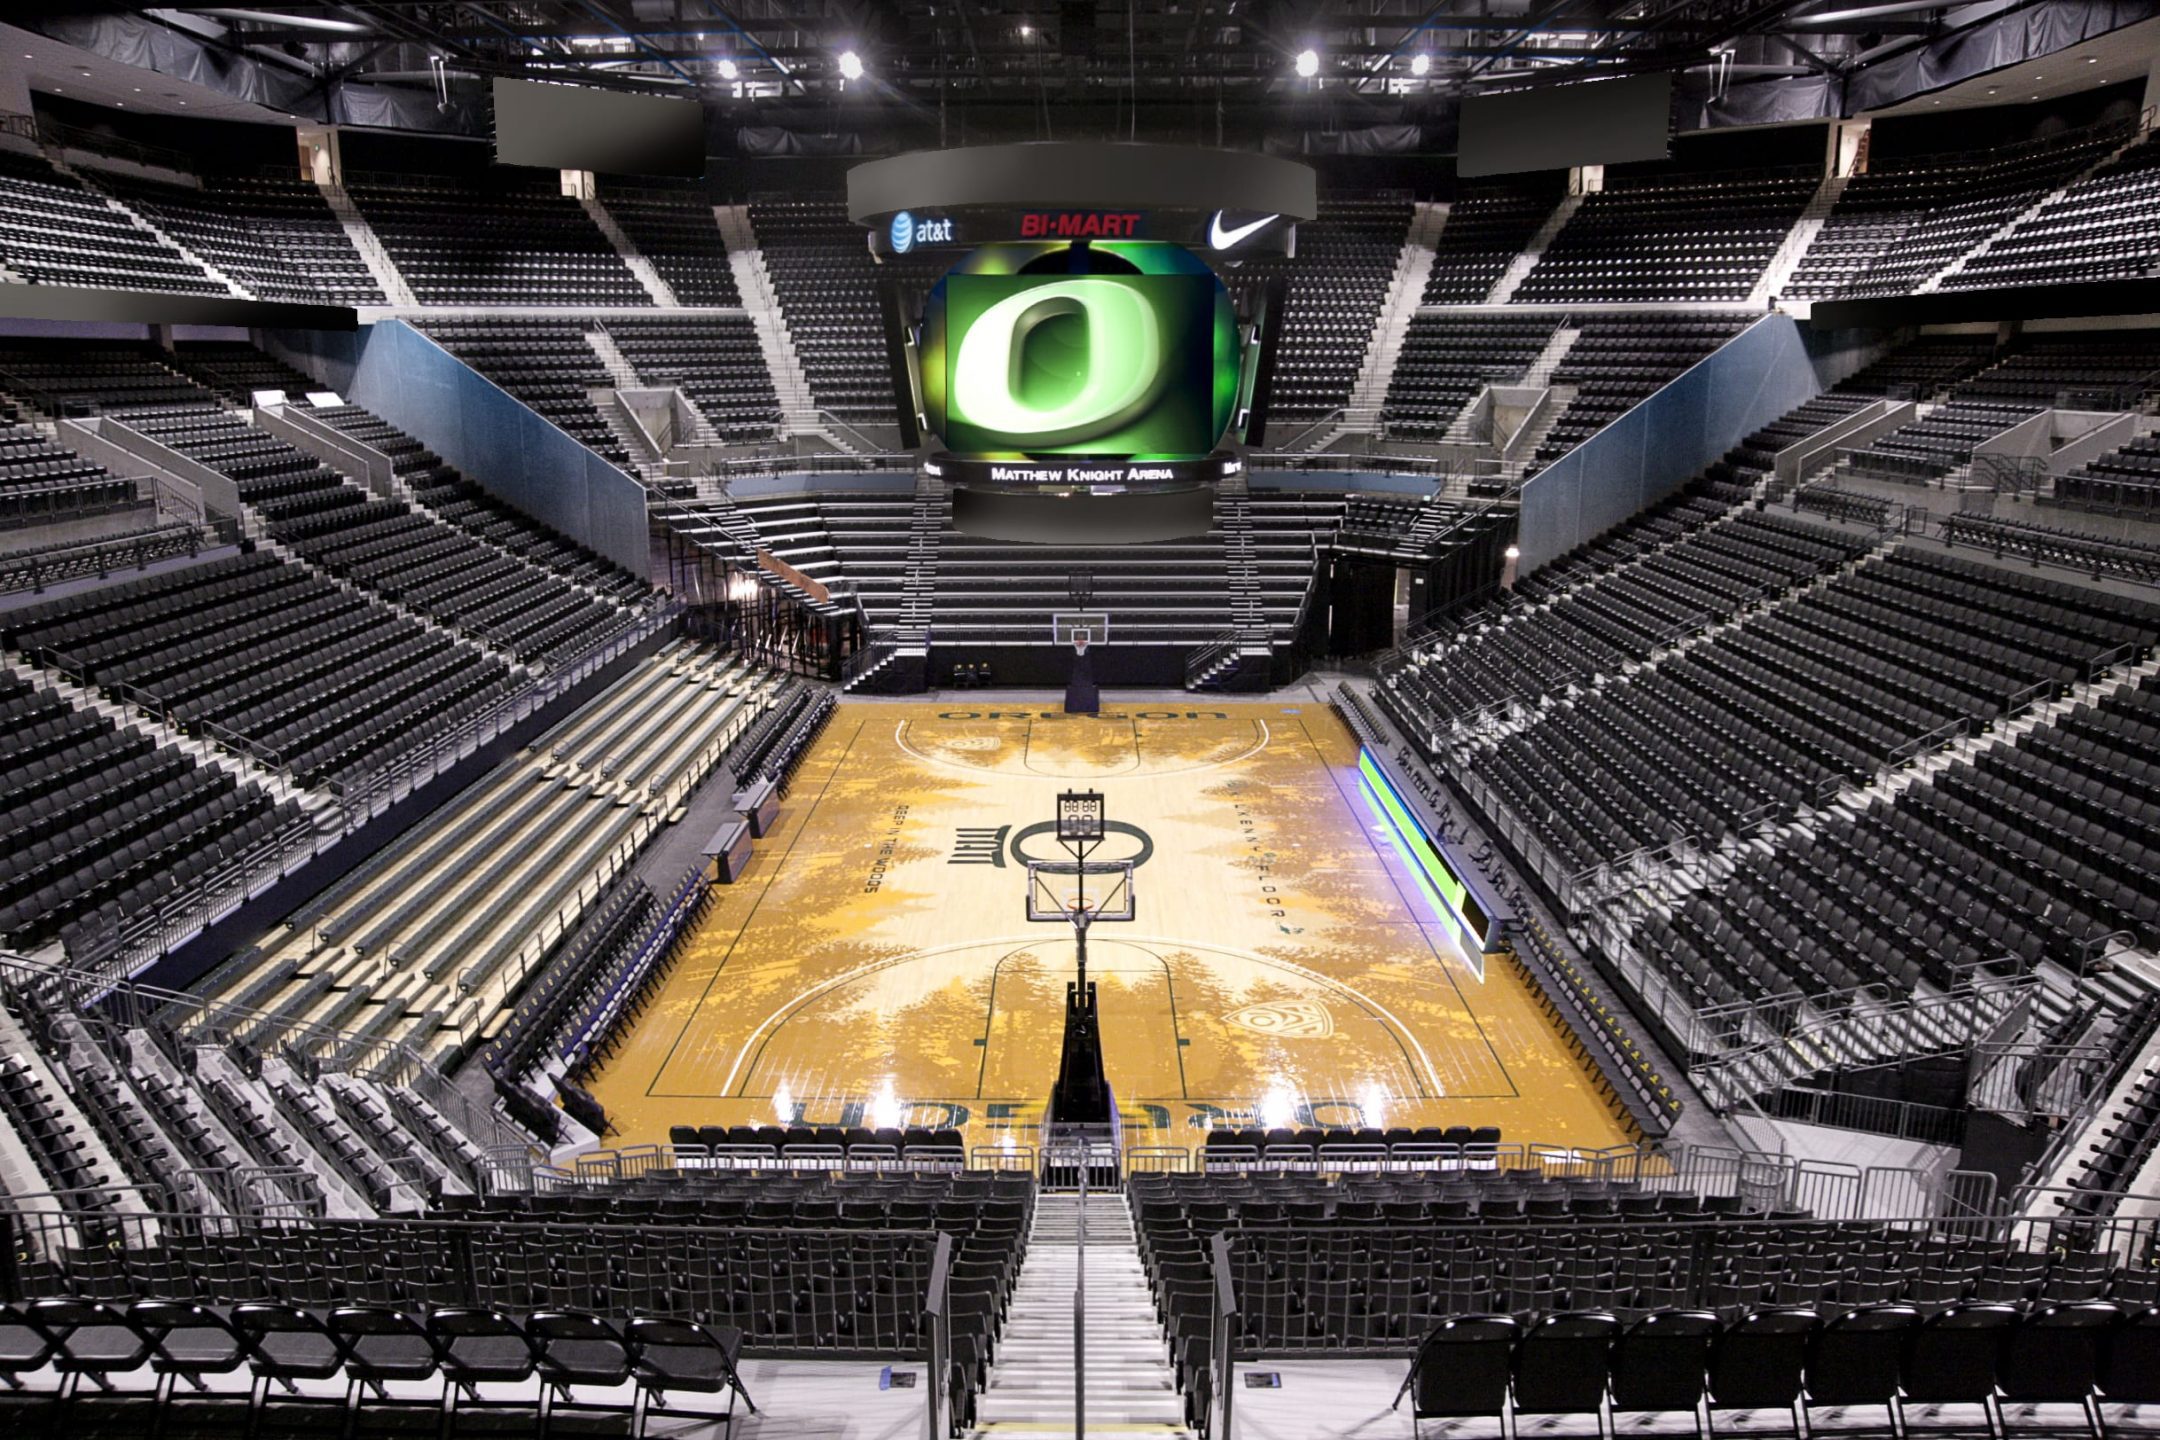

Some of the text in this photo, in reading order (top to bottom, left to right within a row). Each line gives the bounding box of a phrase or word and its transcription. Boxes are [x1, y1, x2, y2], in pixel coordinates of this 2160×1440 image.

[916, 219, 952, 242] at&t
[1066, 468, 1124, 482] KNIGHT
[1127, 467, 1174, 481] ARENA
[864, 857, 890, 892] WOODS
